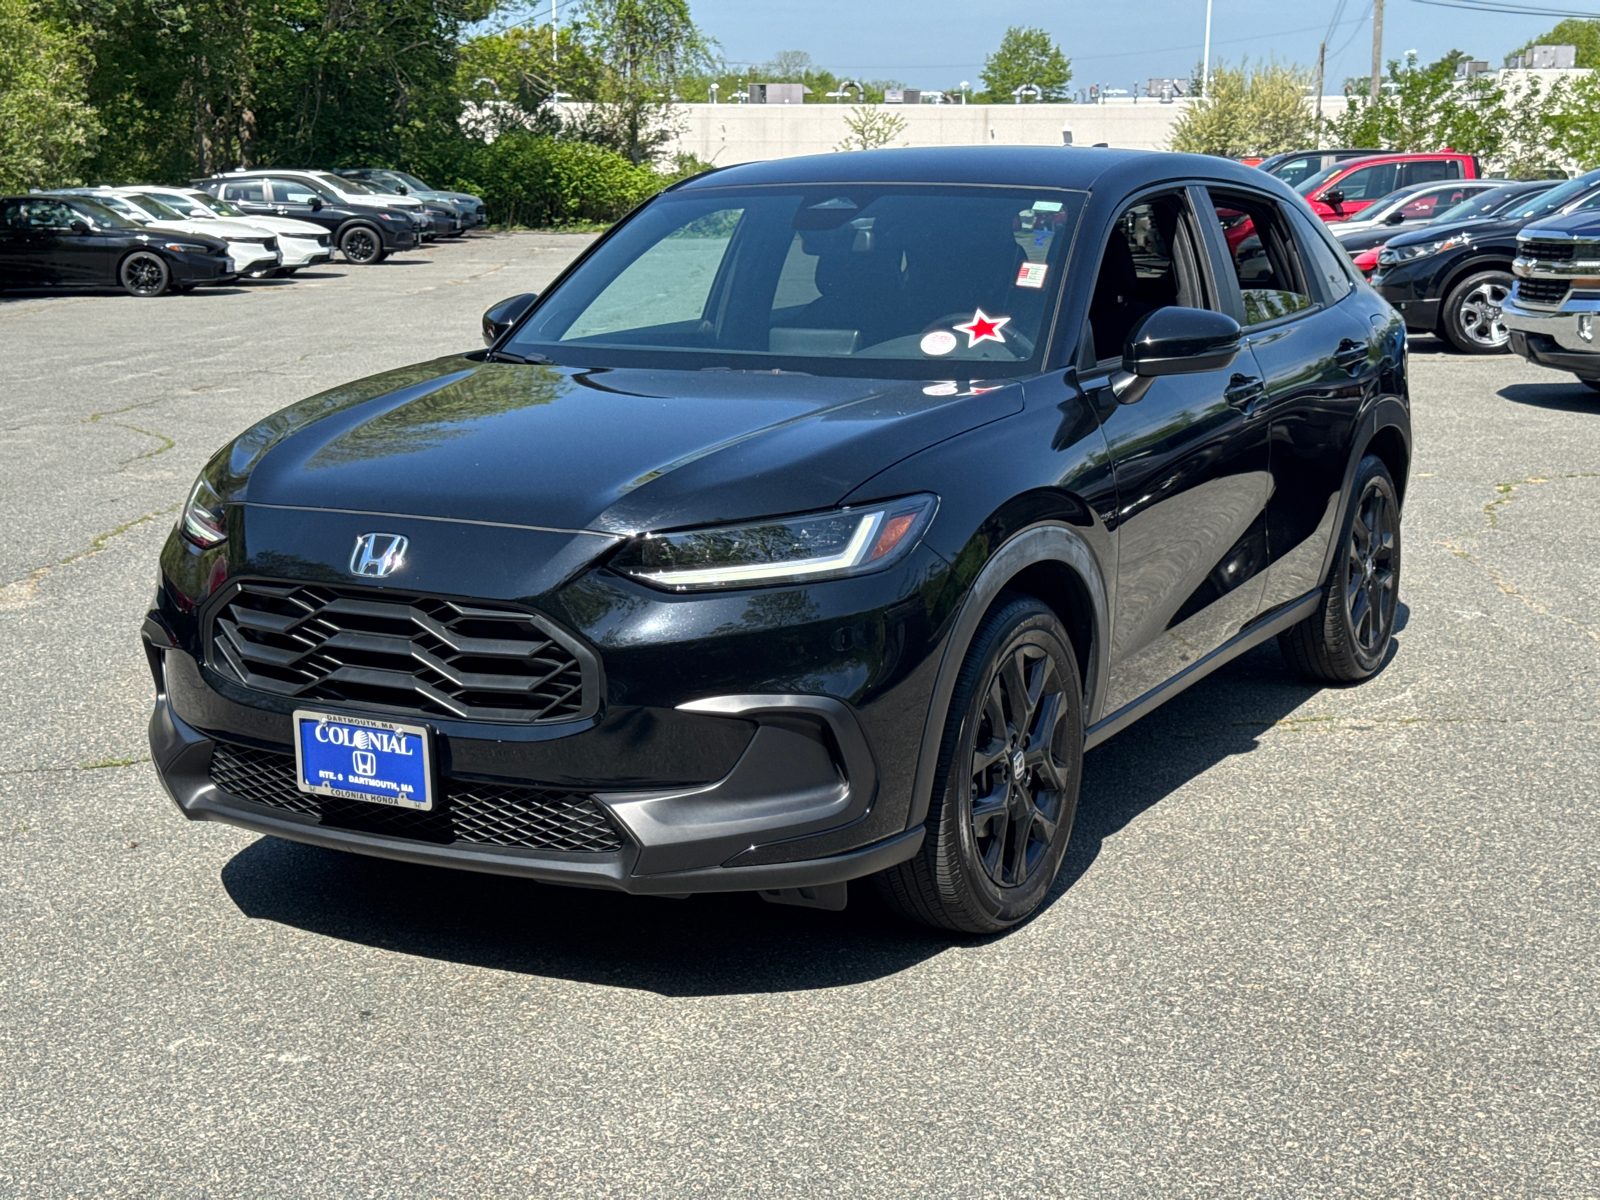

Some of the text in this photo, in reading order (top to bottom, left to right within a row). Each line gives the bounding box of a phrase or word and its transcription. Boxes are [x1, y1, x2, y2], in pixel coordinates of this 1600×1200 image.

[315, 725, 413, 755] COLONIAL
[319, 770, 414, 793] RTE. 6 DARTMOUTH, MA
[330, 789, 399, 805] COLONIAL HONDA
